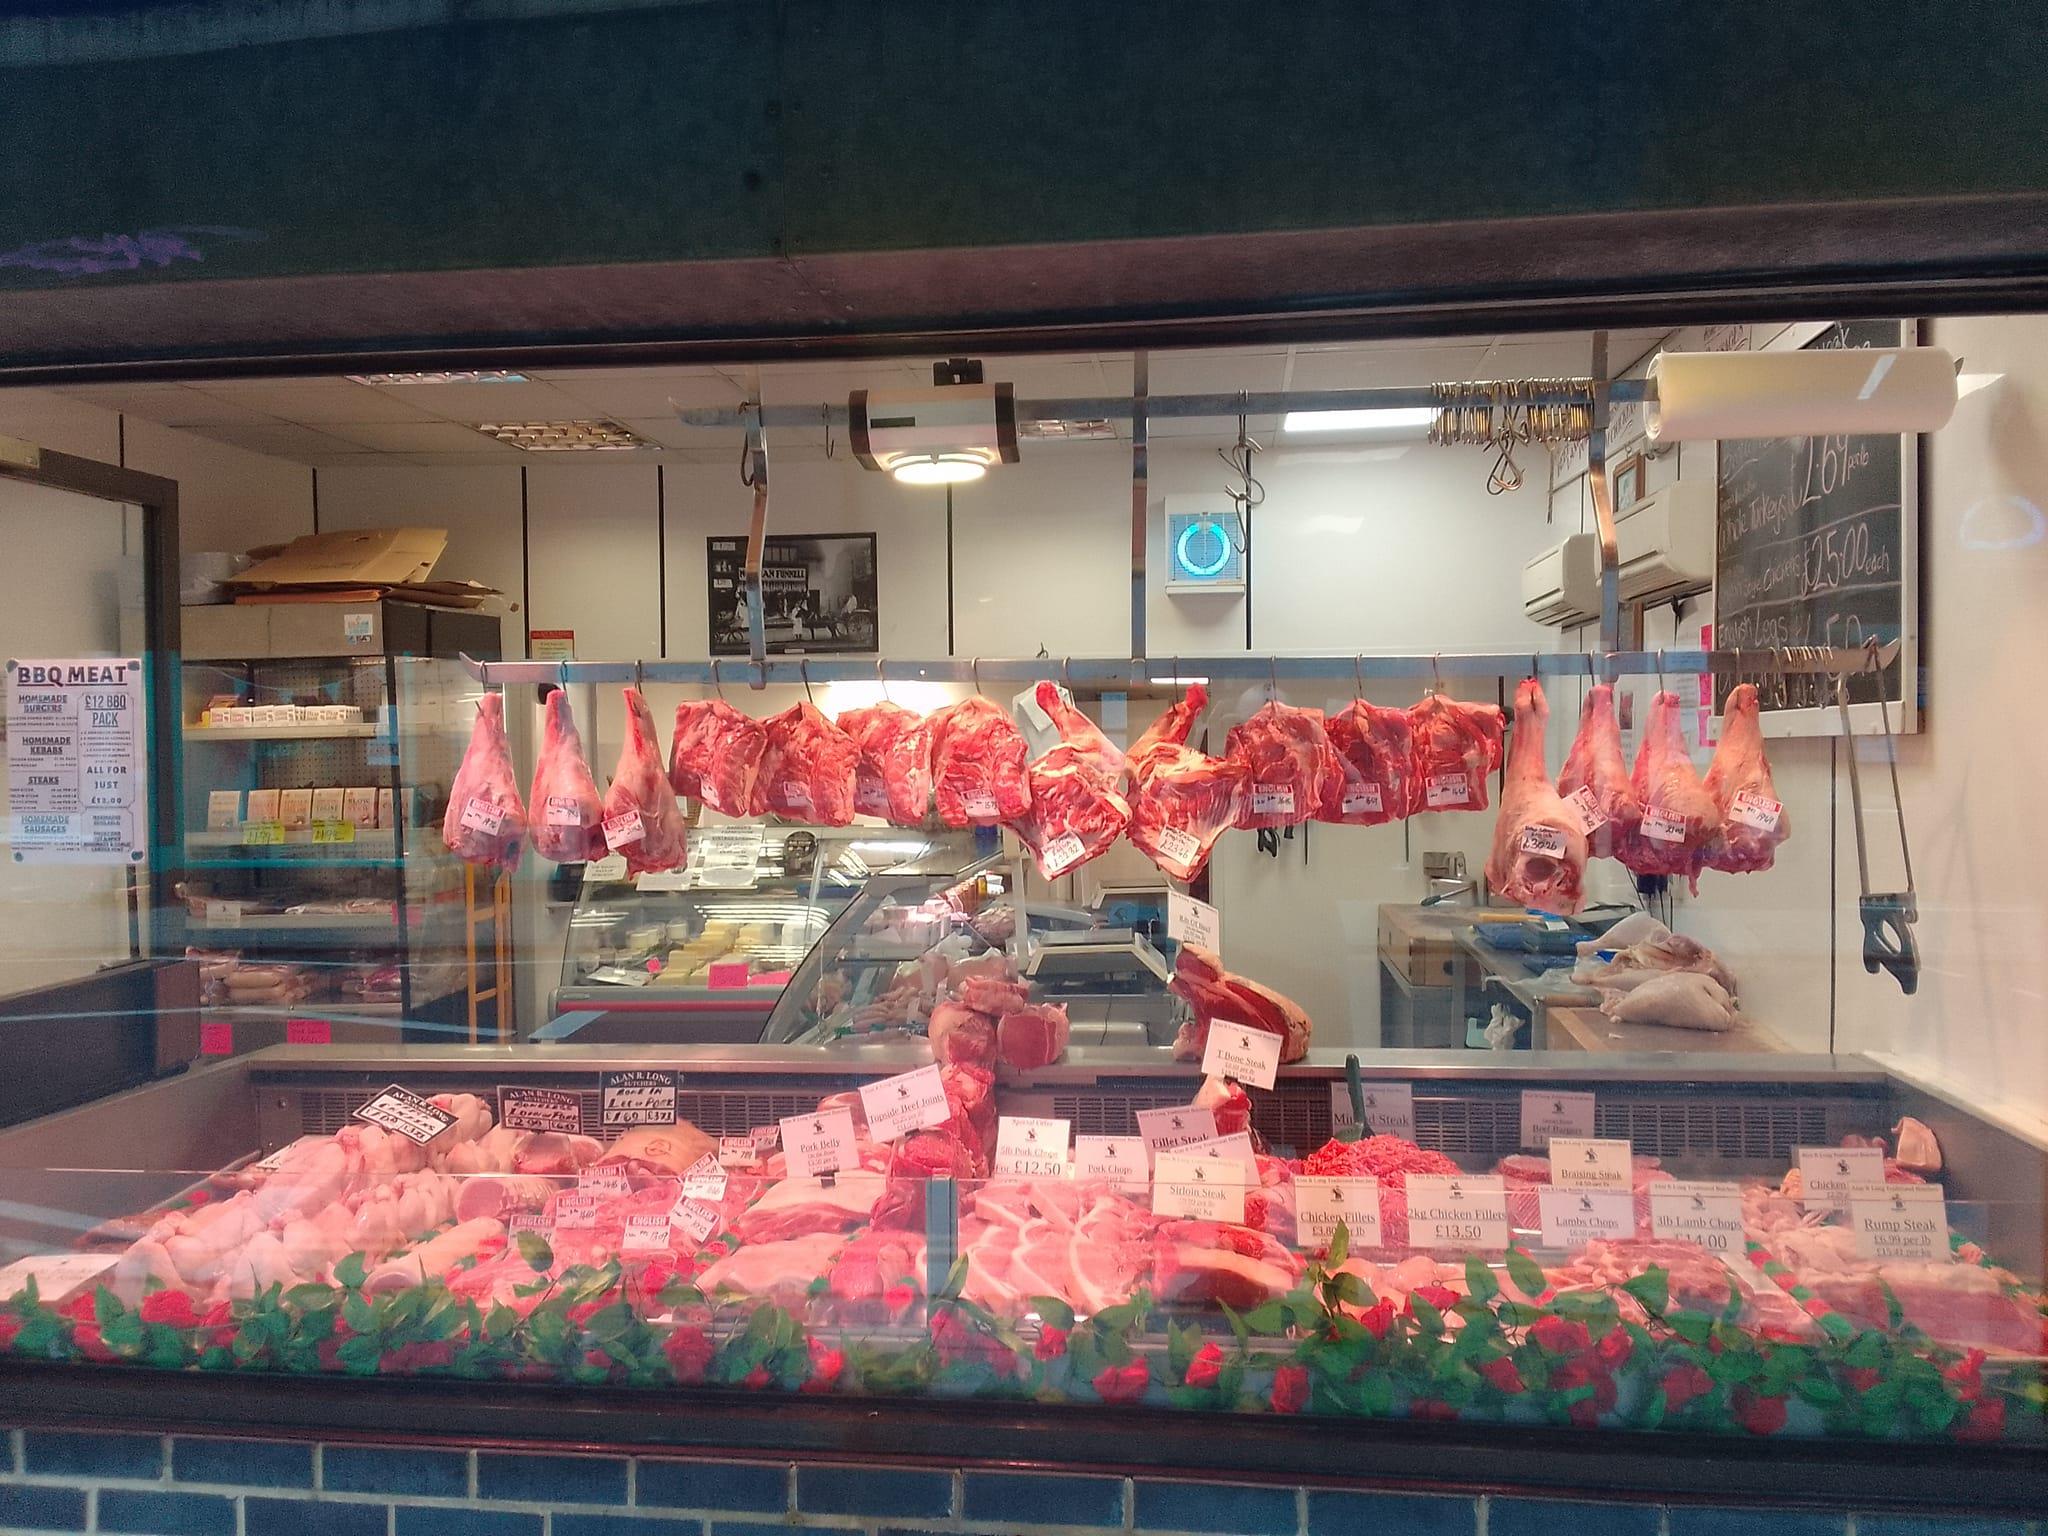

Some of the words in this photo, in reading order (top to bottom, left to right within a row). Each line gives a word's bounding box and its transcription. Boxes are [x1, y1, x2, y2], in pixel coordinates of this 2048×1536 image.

[1865, 545, 1890, 576] each
[17, 666, 64, 686] BBQ
[67, 666, 127, 683] MEAT
[18, 695, 67, 703] HOMEMADE
[85, 696, 104, 708] £12
[106, 695, 126, 708] BBQ
[92, 712, 118, 726] PACK
[22, 736, 71, 745] HOMEMADE
[31, 746, 63, 755] KEBABS
[87, 766, 104, 774] ALL
[107, 766, 127, 774] FOR
[28, 776, 59, 785] STEAKS
[95, 781, 118, 789] JUST
[21, 815, 69, 824] HOMEMADE
[24, 825, 67, 834] SAUSAGES
[1246, 1056, 1266, 1070] Steak
[611, 1072, 634, 1085] ALAN
[646, 1071, 671, 1085] LONG
[510, 1090, 534, 1099] ALAN
[547, 1092, 573, 1105] LONG
[901, 1100, 920, 1114] Beef
[1334, 1112, 1375, 1126] Mind
[1380, 1112, 1409, 1126] Steak
[800, 1142, 818, 1153] Pork
[820, 1138, 840, 1150] Belly
[1152, 1137, 1178, 1148] Fillet
[1181, 1133, 1209, 1145] Steak
[1014, 1160, 1061, 1176] £12.50
[1088, 1164, 1106, 1174] Pork
[1108, 1165, 1133, 1175] Chops
[1561, 1169, 1597, 1180] Braising
[1599, 1169, 1622, 1180] Steak
[1810, 1180, 1846, 1191] Chicken
[1170, 1185, 1200, 1197] Sirloin
[1202, 1188, 1227, 1200] Steak
[1300, 1212, 1341, 1223] Chicken
[1345, 1211, 1376, 1224] Fillets
[1409, 1208, 1427, 1221] 2kg
[1430, 1208, 1472, 1220] Chicken
[1556, 1216, 1587, 1227] Lambs
[1589, 1217, 1619, 1229] Chops
[1657, 1216, 1673, 1226] 3lb
[1676, 1216, 1706, 1227] Lamb
[1710, 1218, 1742, 1231] Chops
[1865, 1218, 1901, 1232] Rump
[1905, 1218, 1936, 1231] Steak
[1435, 1225, 1482, 1239] £13.50
